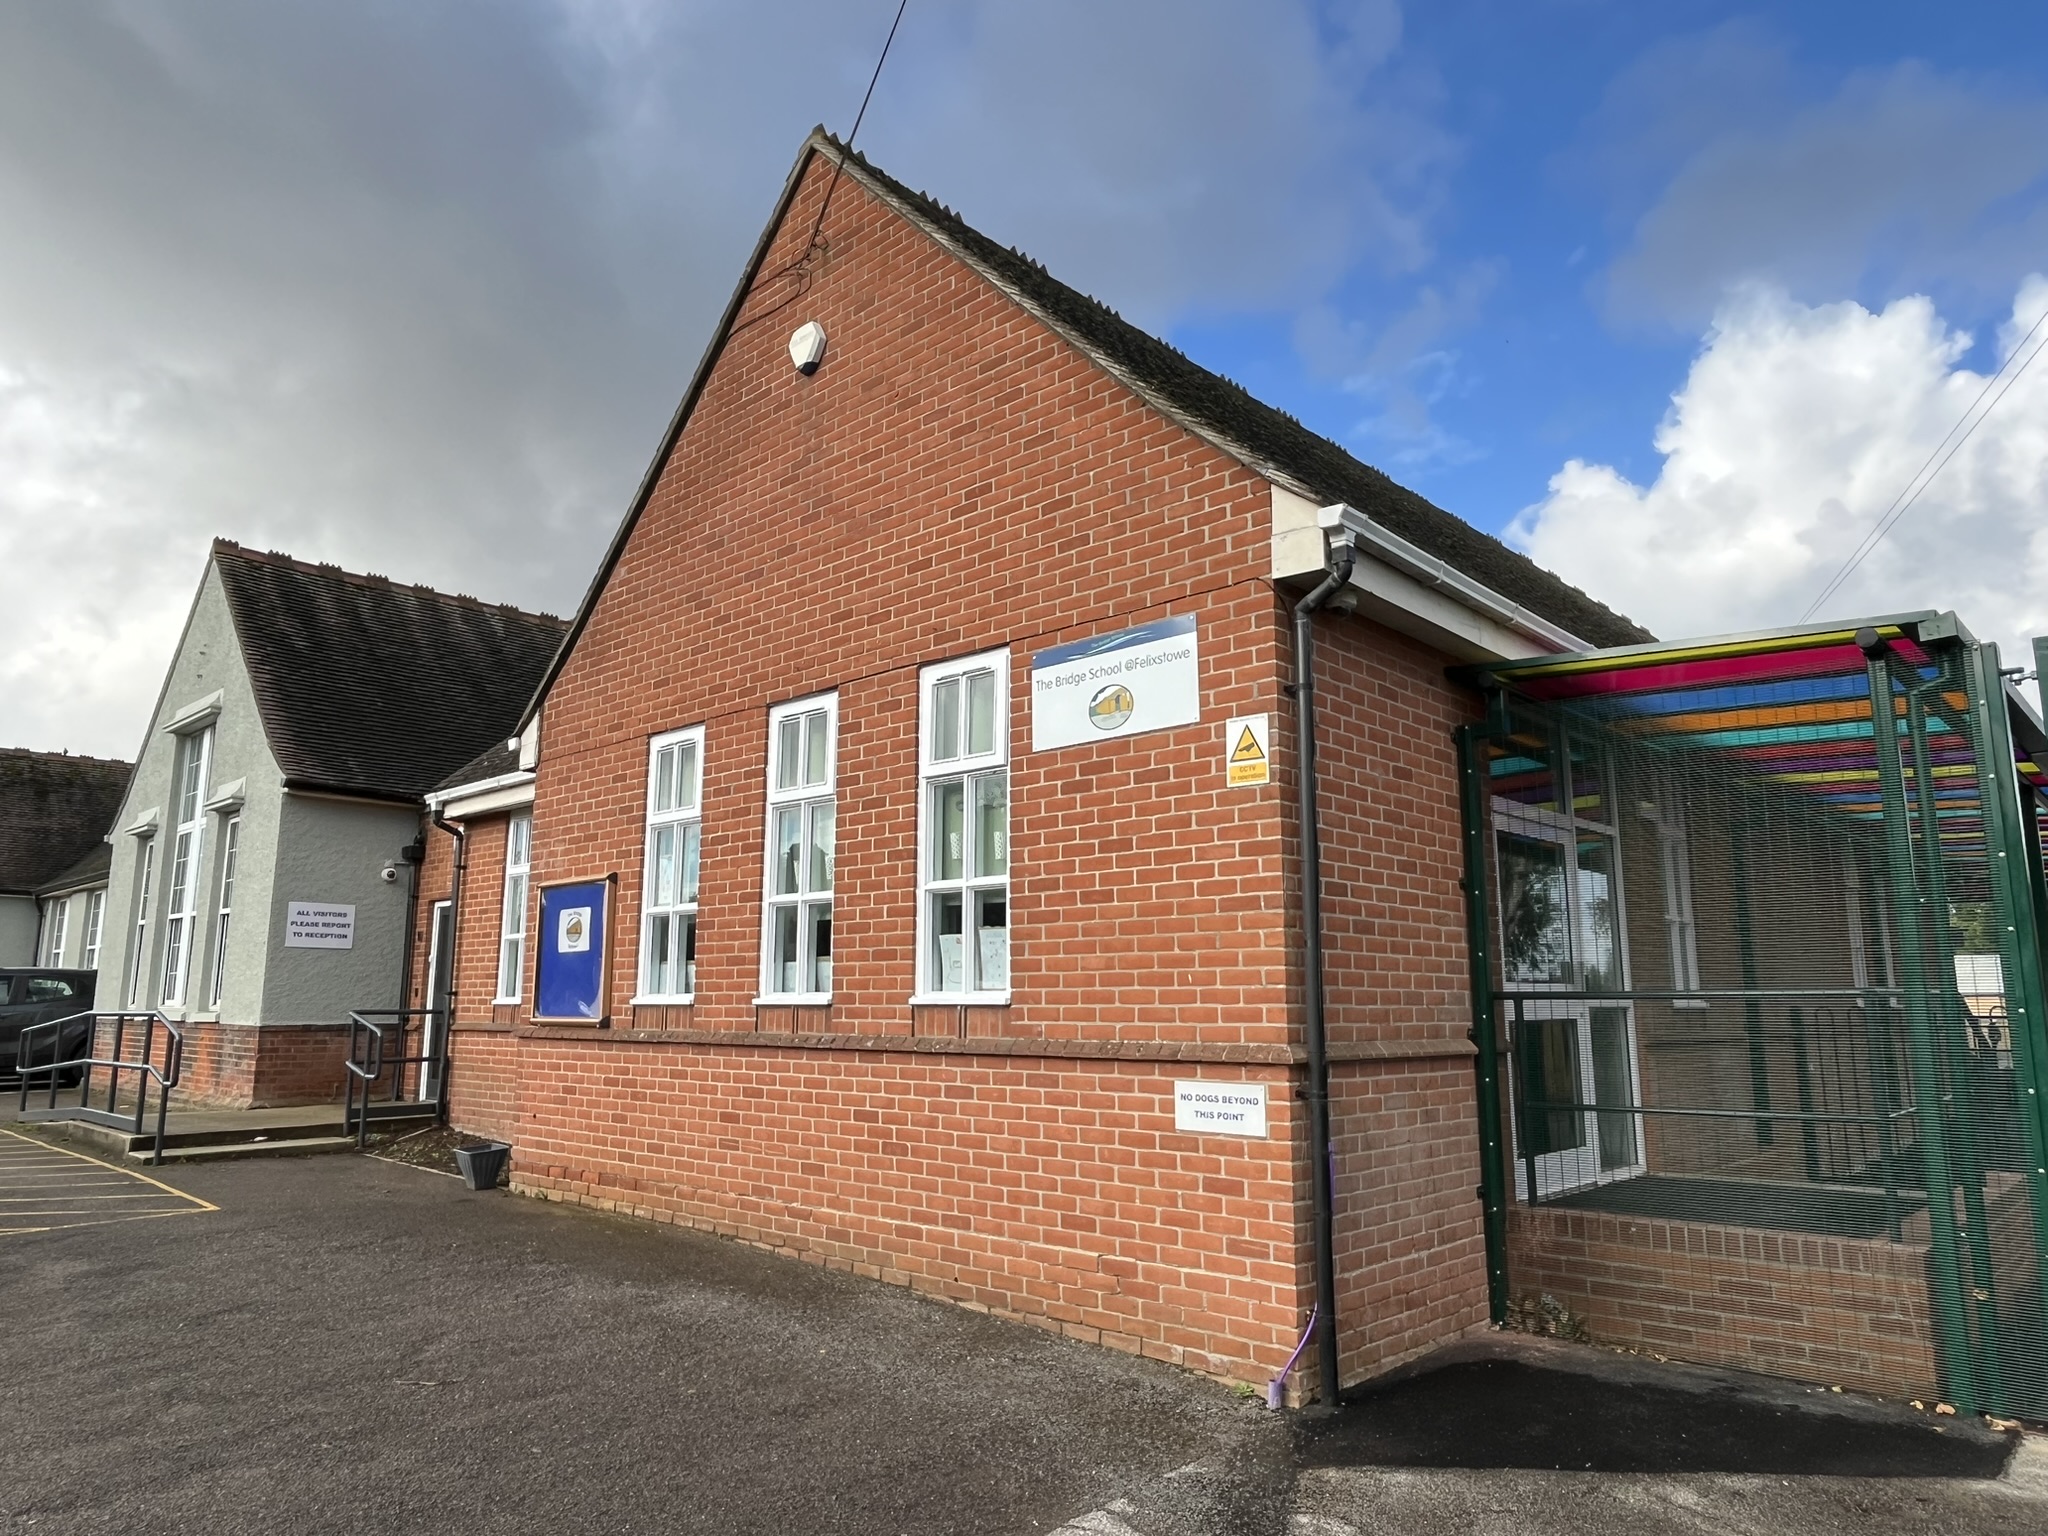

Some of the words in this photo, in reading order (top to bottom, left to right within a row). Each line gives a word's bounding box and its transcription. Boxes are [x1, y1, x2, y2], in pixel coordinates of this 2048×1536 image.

[1036, 679, 1053, 692] The
[1055, 672, 1087, 687] Bridge
[1088, 661, 1122, 680] School
[1124, 649, 1191, 672] @Felixstowe
[290, 920, 320, 928] PLEASE
[1180, 1093, 1193, 1102] NO
[1195, 1093, 1220, 1104] DOGS
[1221, 1095, 1259, 1106] BEYOND
[1194, 1109, 1215, 1120] THIS
[1217, 1111, 1245, 1122] POINT
